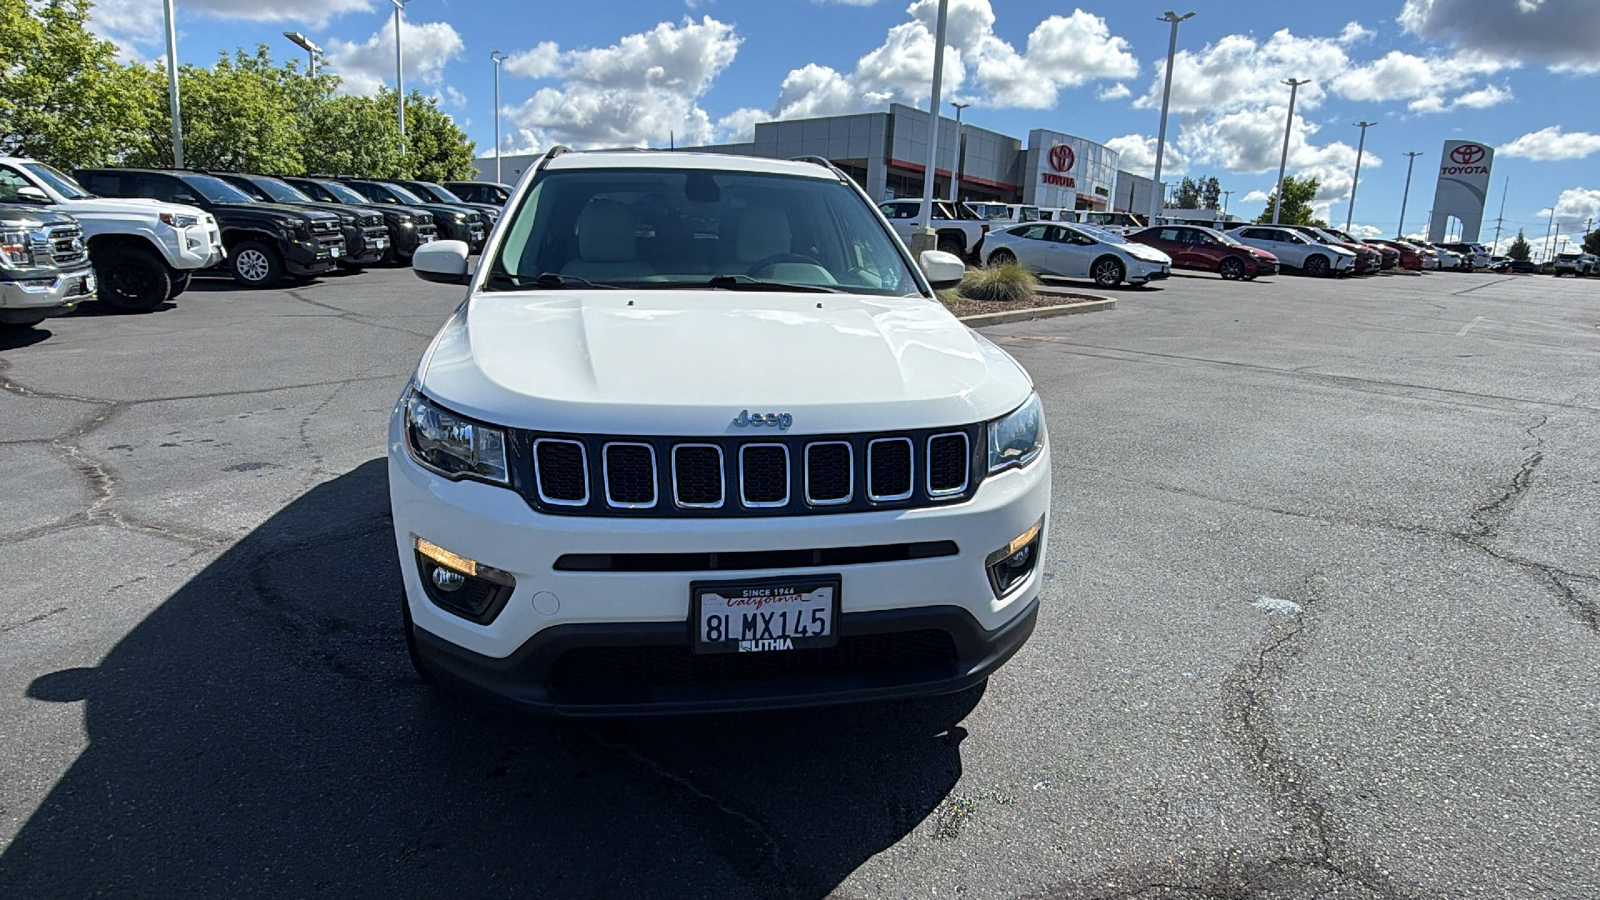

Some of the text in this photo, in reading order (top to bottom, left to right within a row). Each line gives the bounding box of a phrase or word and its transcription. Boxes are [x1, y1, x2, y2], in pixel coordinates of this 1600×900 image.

[1441, 166, 1488, 175] TOYOTA
[1041, 173, 1075, 188] TOYOTA
[733, 409, 793, 430] Jeep
[742, 587, 795, 598] SINCE 1946
[706, 608, 826, 642] 8LMX145
[751, 638, 794, 652] LITHIA
